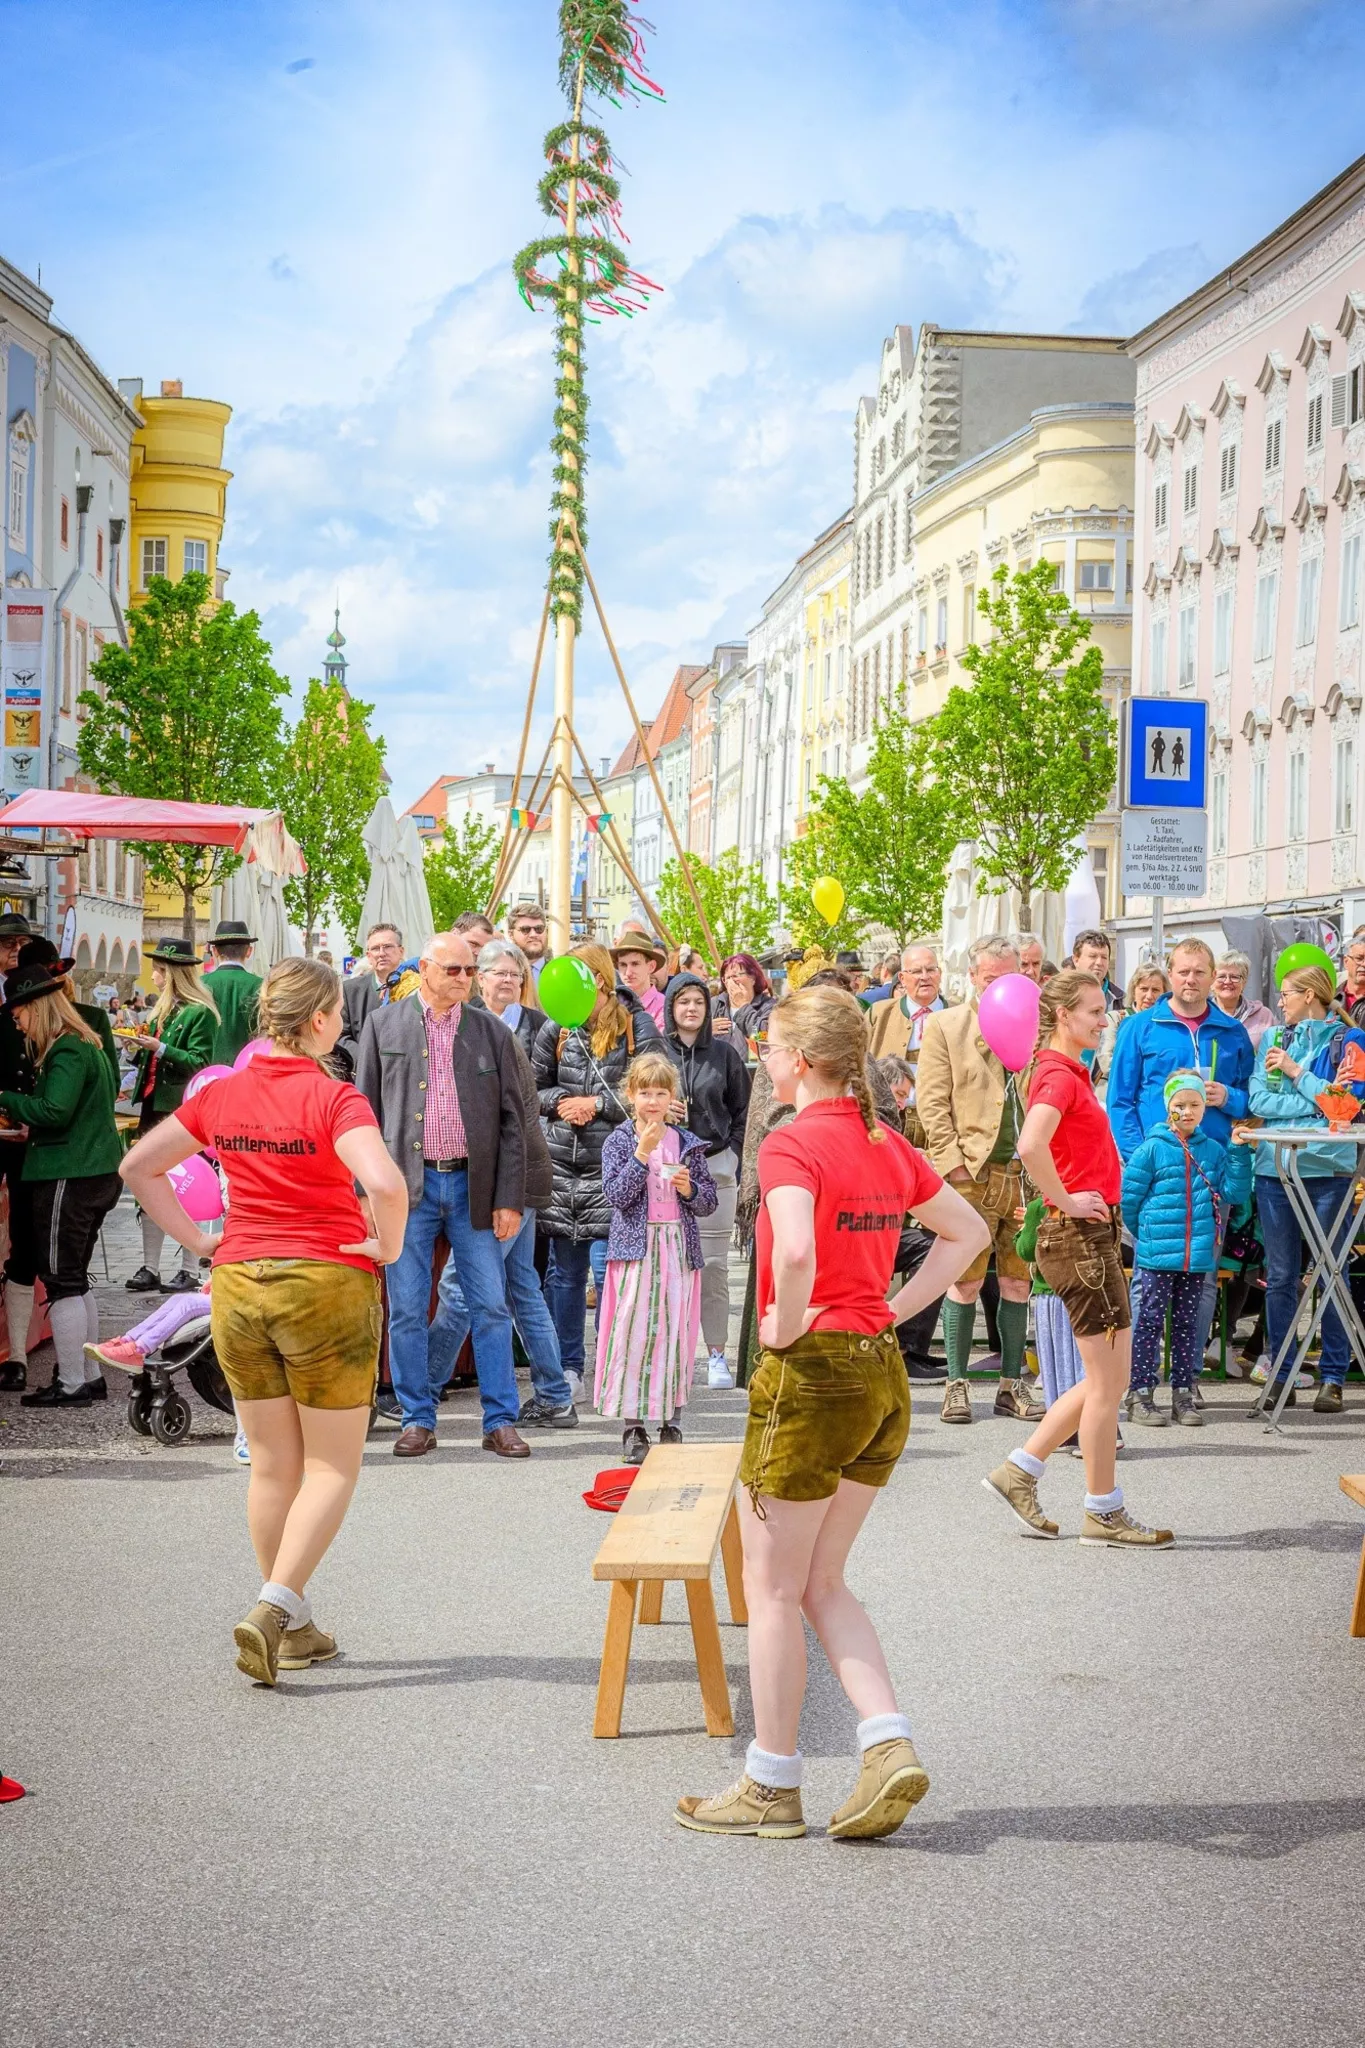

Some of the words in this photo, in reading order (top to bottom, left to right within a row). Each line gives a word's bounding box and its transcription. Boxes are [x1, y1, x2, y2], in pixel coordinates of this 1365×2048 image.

[1150, 816, 1181, 825] Gestattet:
[1155, 826, 1160, 834] 1.
[1161, 826, 1176, 835] Taxi,
[1146, 835, 1152, 843] 2.
[1153, 835, 1184, 844] Radfahrer,
[1126, 843, 1132, 851] 3.
[1133, 843, 1180, 853] Ladetätigkeiten
[1181, 845, 1192, 853] und
[1193, 845, 1203, 853] Kfz
[1144, 853, 1198, 862] Handelsvertretern
[1125, 864, 1140, 872] gem.
[1142, 862, 1156, 872] §76a
[1157, 864, 1170, 872] Abs.
[1170, 864, 1175, 872] 2
[1176, 864, 1183, 872] Z.
[1183, 864, 1188, 872] 4
[1188, 864, 1203, 873] StVO
[1148, 874, 1180, 883] werktags
[1142, 882, 1161, 890] 06.00
[1168, 883, 1186, 891] 10.00
[1187, 883, 1199, 891] Uhr
[214, 1135, 316, 1155] Plattlermädl's
[176, 1173, 196, 1195] WELS
